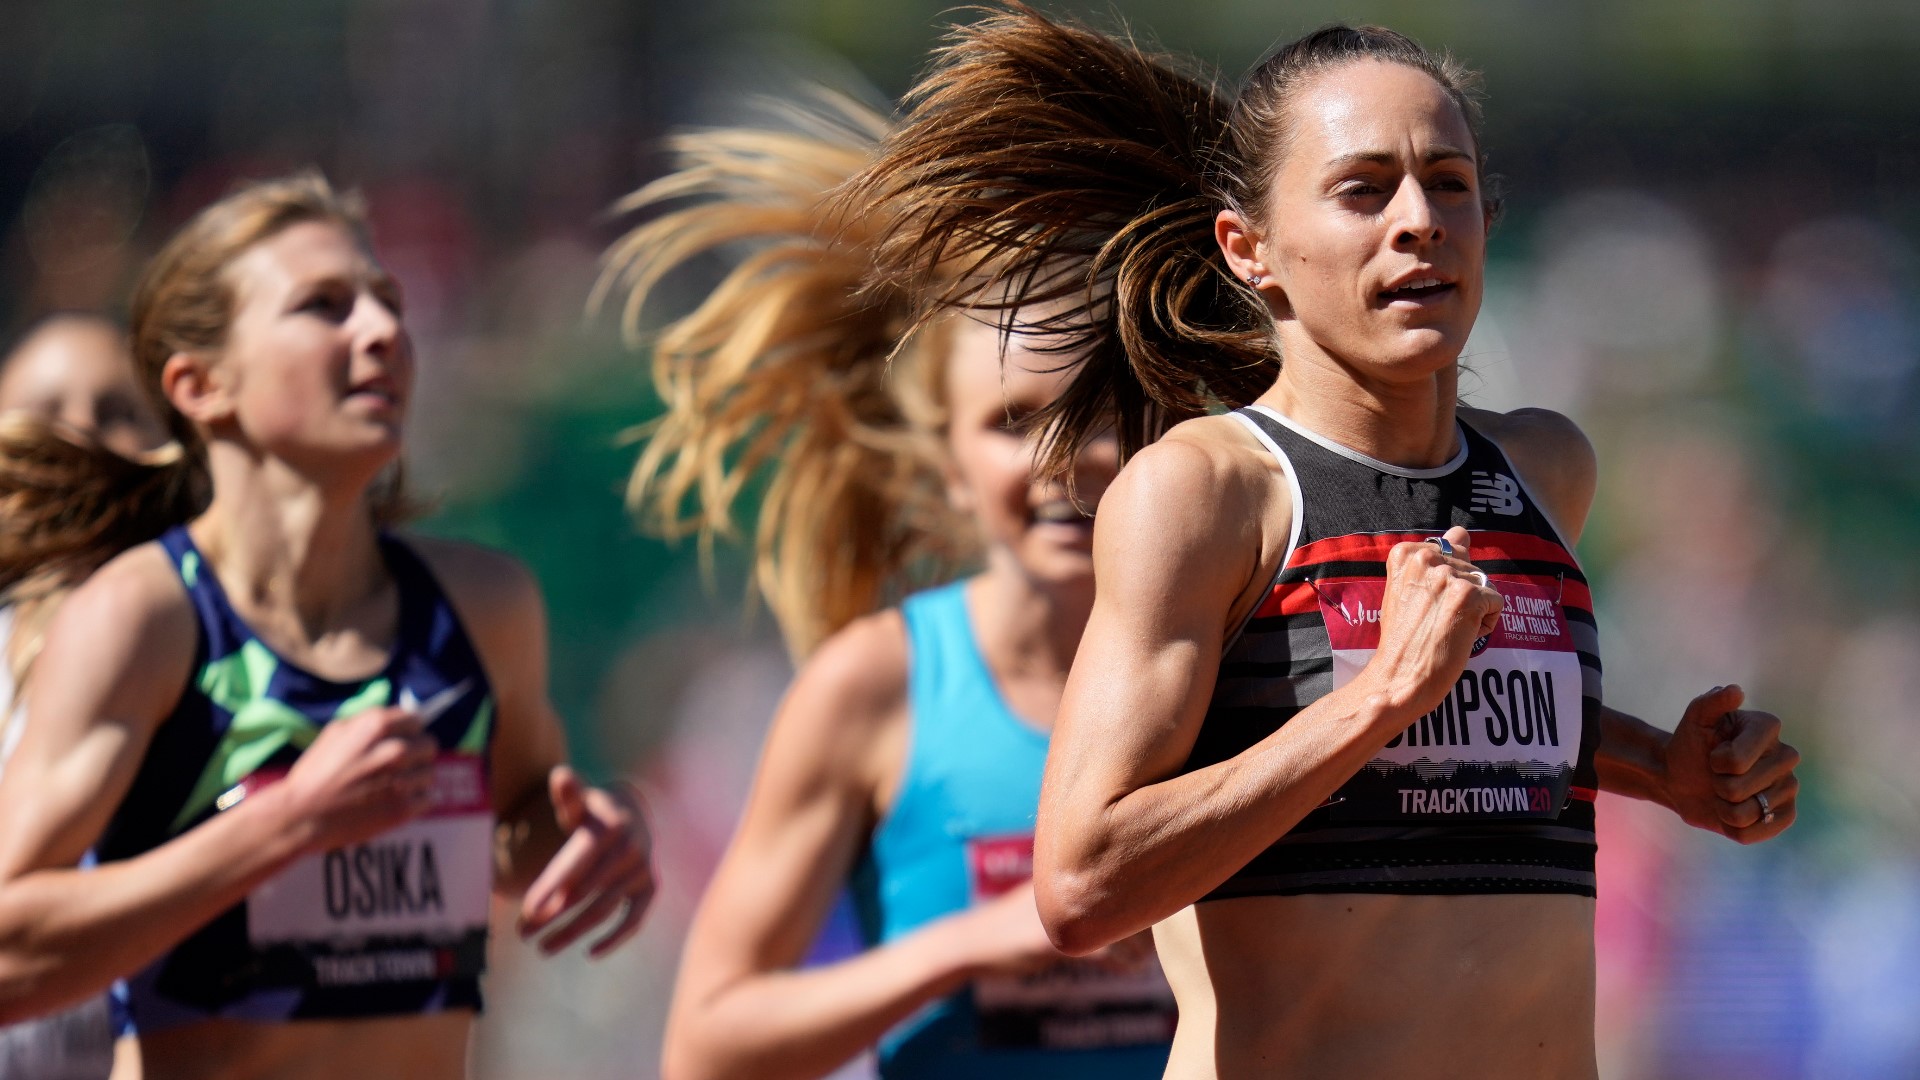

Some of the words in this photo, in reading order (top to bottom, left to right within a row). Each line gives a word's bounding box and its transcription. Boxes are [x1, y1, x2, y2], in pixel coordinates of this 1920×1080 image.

[1516, 596, 1555, 618] OLYMPIC
[1501, 613, 1527, 633] TEAM
[1526, 616, 1560, 636] TRIALS
[1504, 633, 1524, 641] TRACK
[1530, 635, 1546, 643] FIELD
[1384, 669, 1559, 748] MPSON
[324, 841, 444, 919] OSIKA
